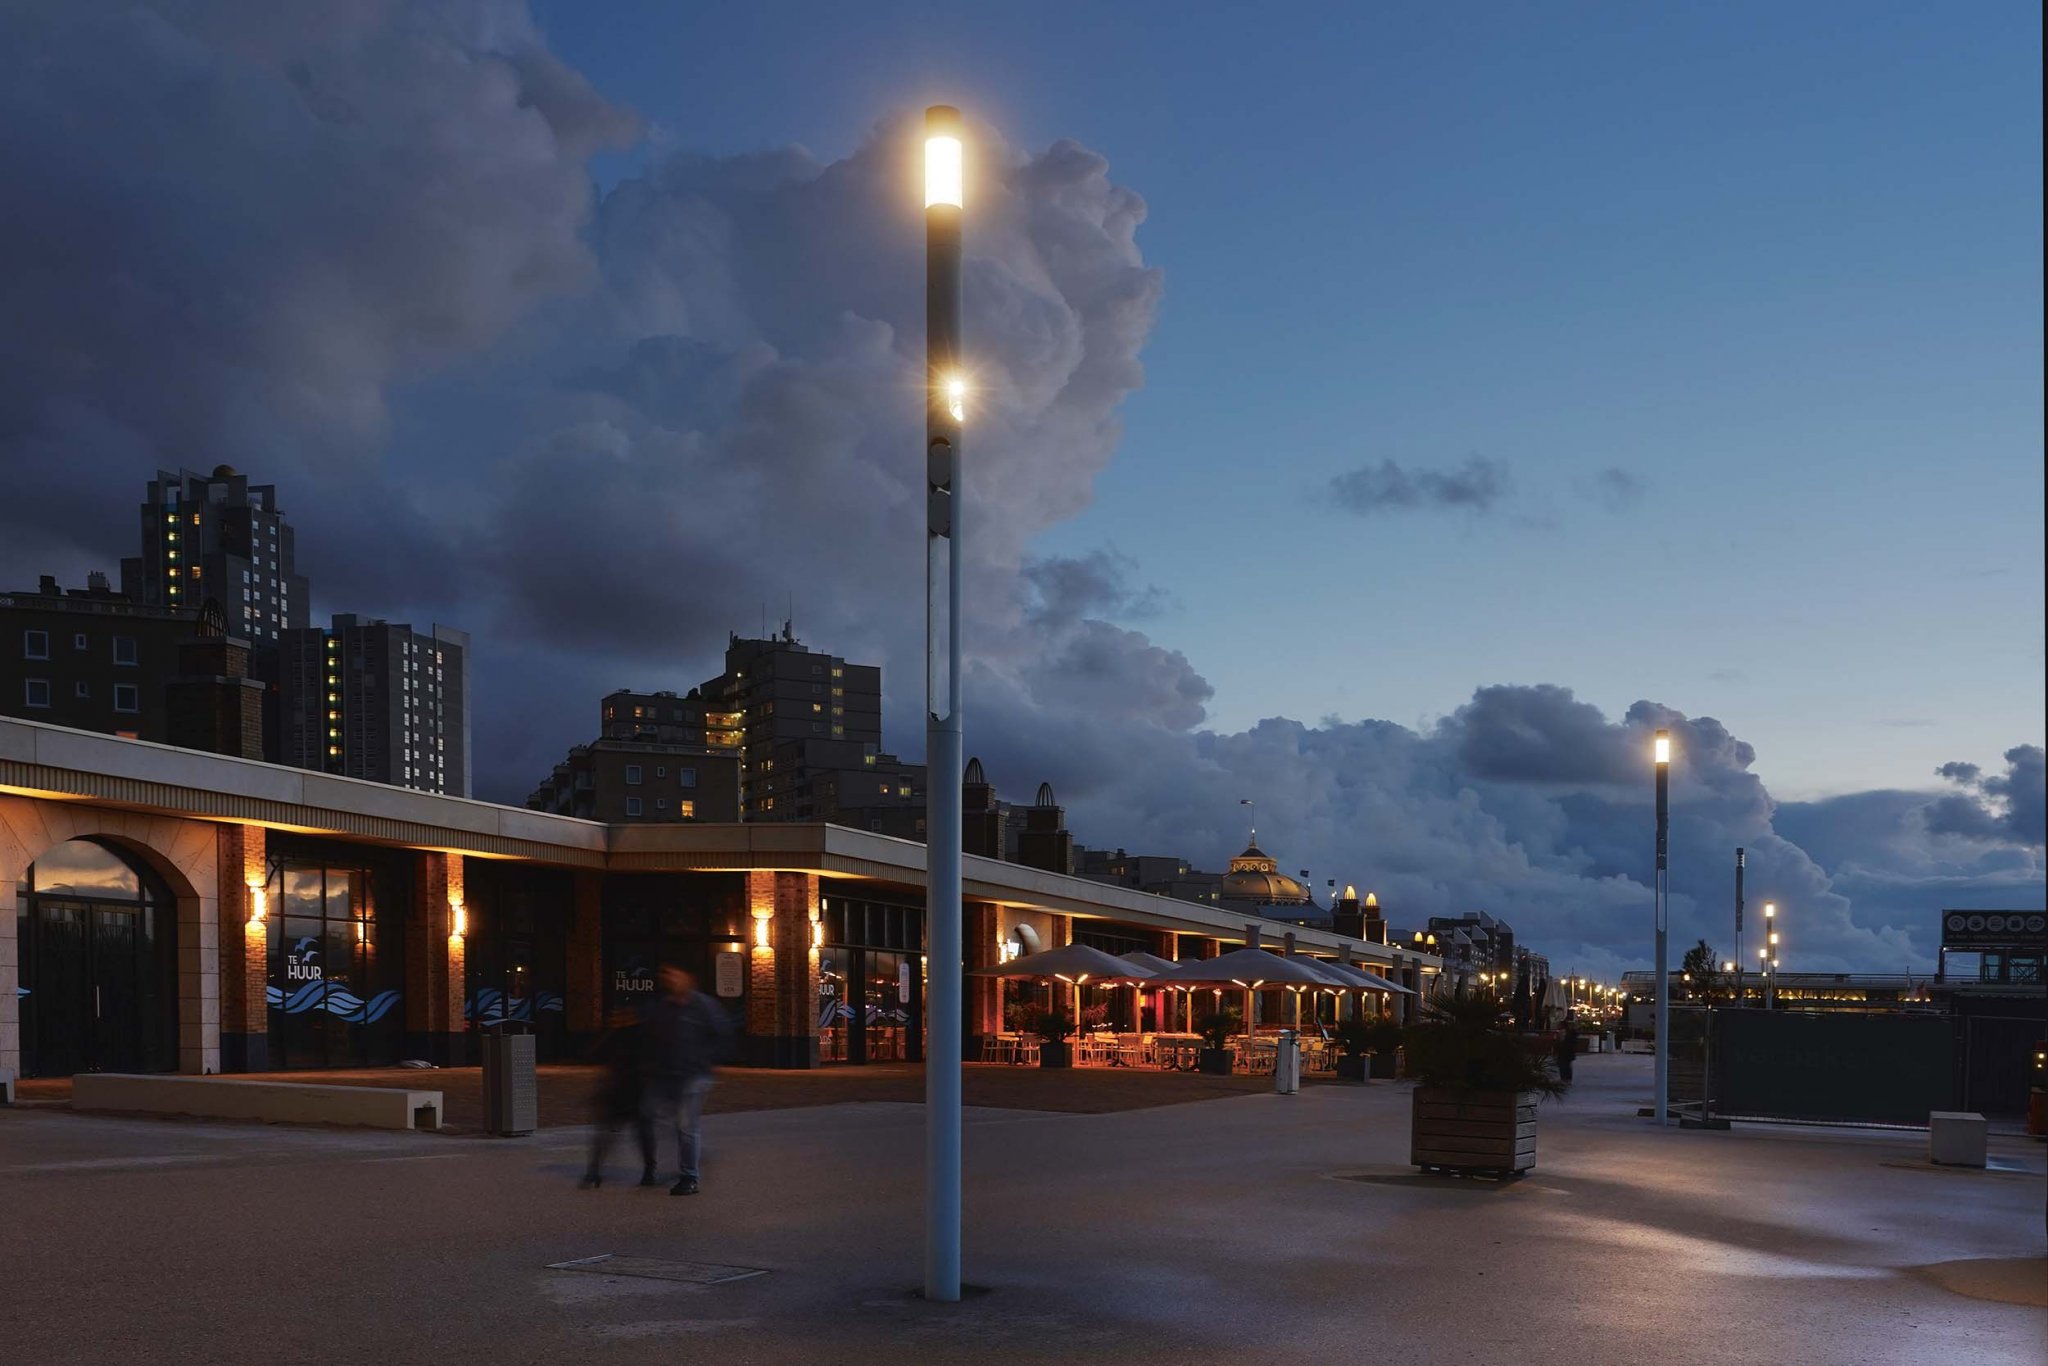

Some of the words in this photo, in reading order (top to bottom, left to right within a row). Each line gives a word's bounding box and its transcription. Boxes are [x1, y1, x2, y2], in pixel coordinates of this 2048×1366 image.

[288, 955, 298, 965] TE
[288, 965, 322, 980] HUUR
[616, 971, 627, 979] TE
[616, 979, 654, 991] HUUR
